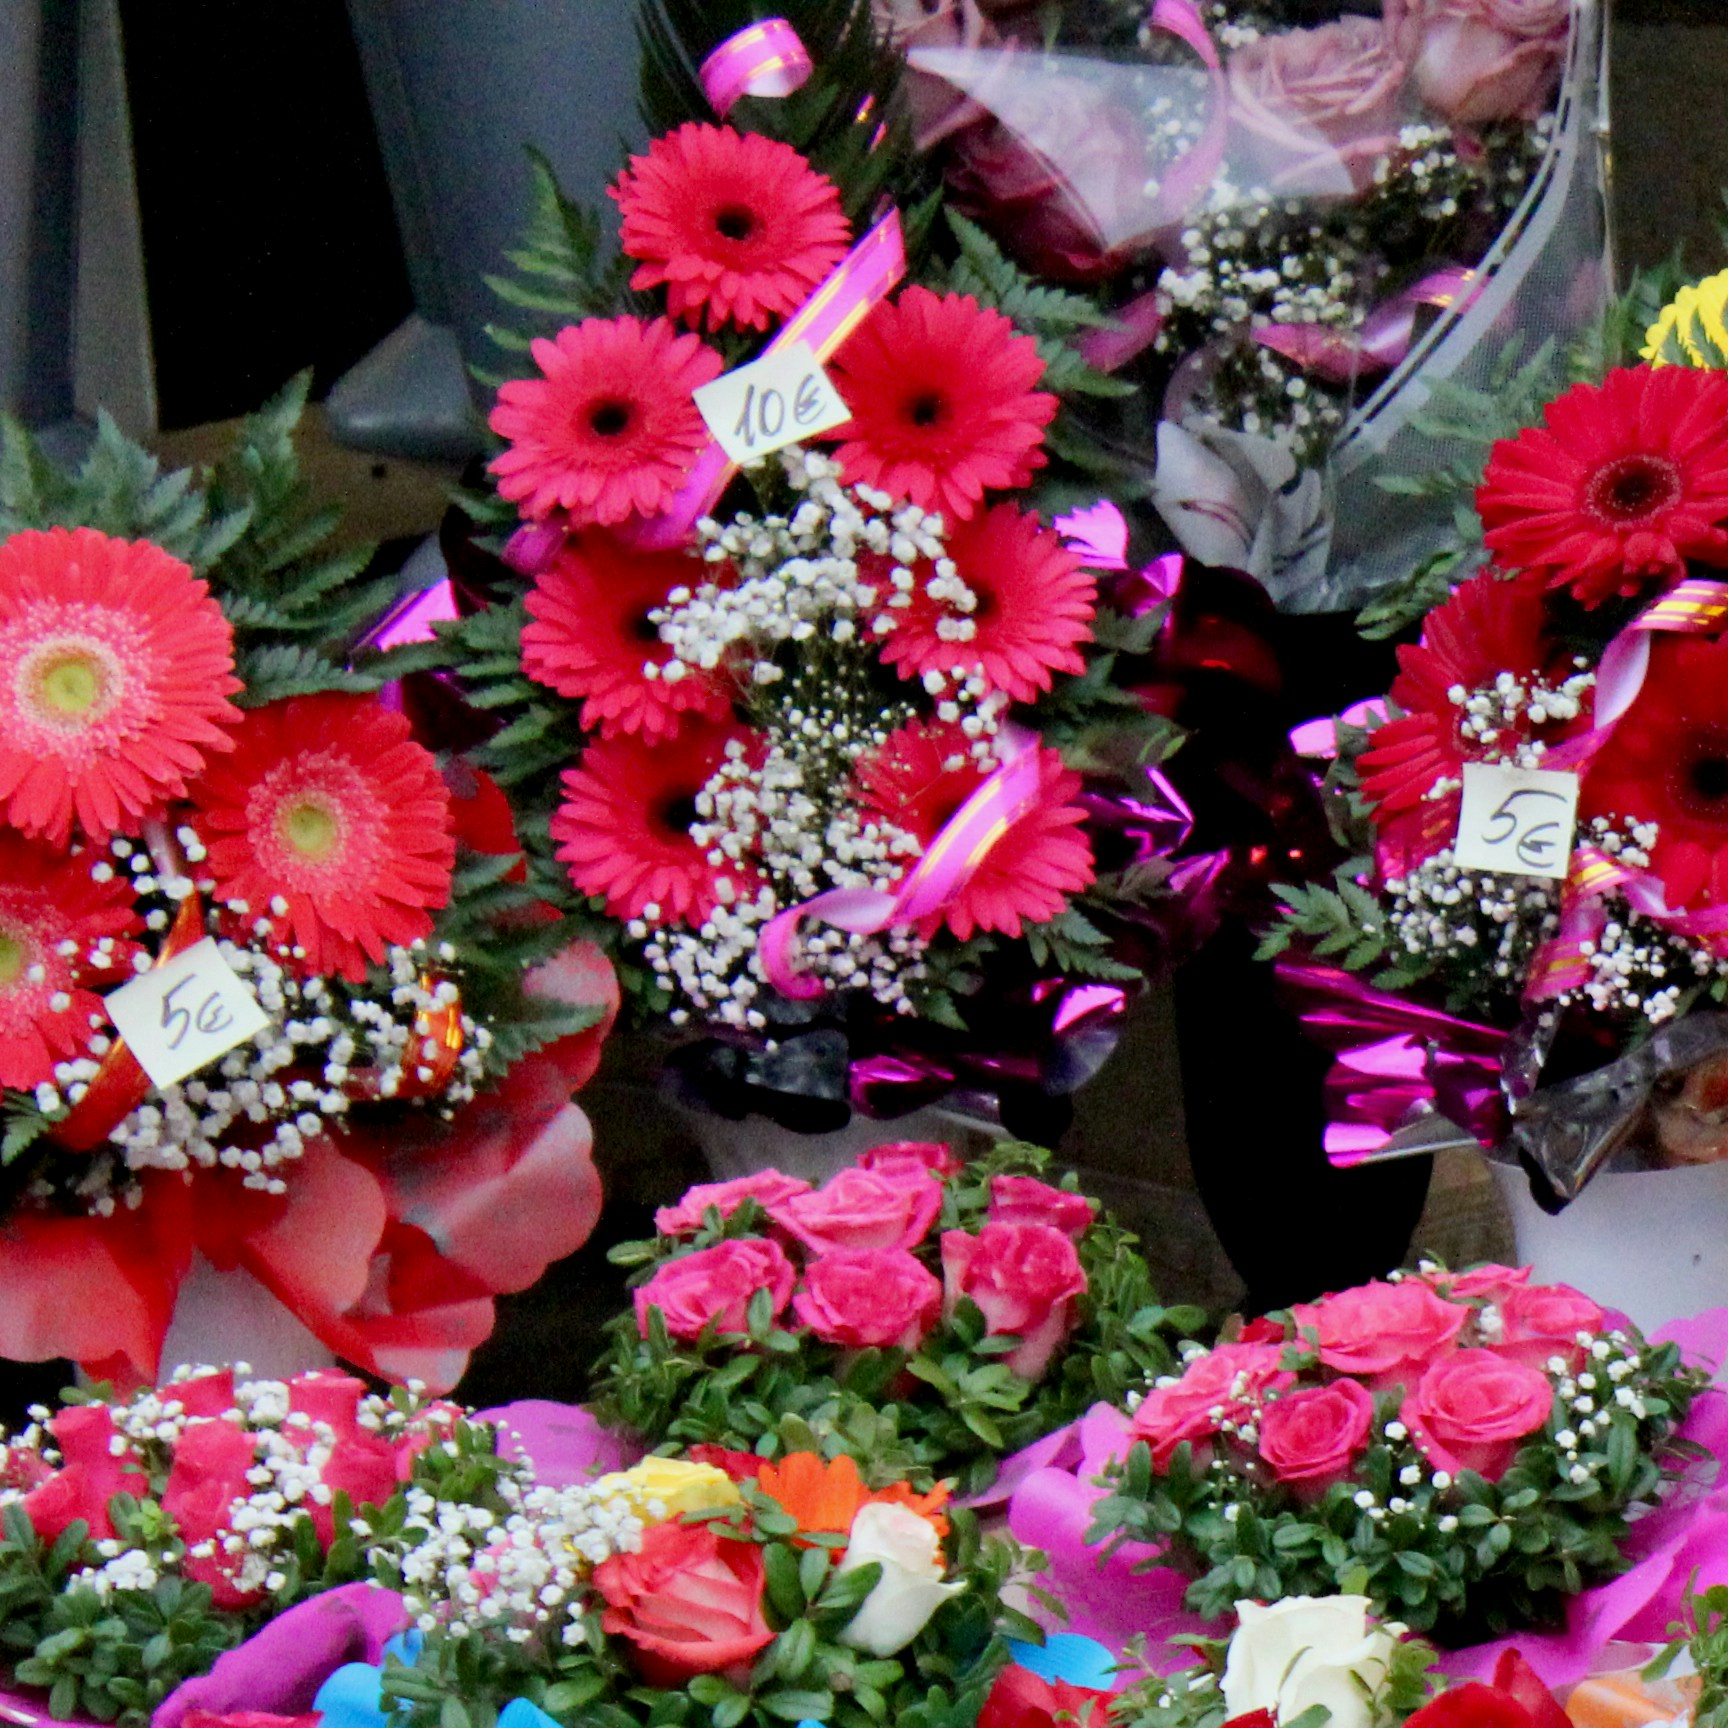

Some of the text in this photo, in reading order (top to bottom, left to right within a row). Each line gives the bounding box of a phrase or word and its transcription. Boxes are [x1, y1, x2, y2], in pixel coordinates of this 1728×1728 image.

[733, 373, 827, 448] 10€
[1481, 789, 1568, 869] 5€
[160, 973, 233, 1050] 5€
